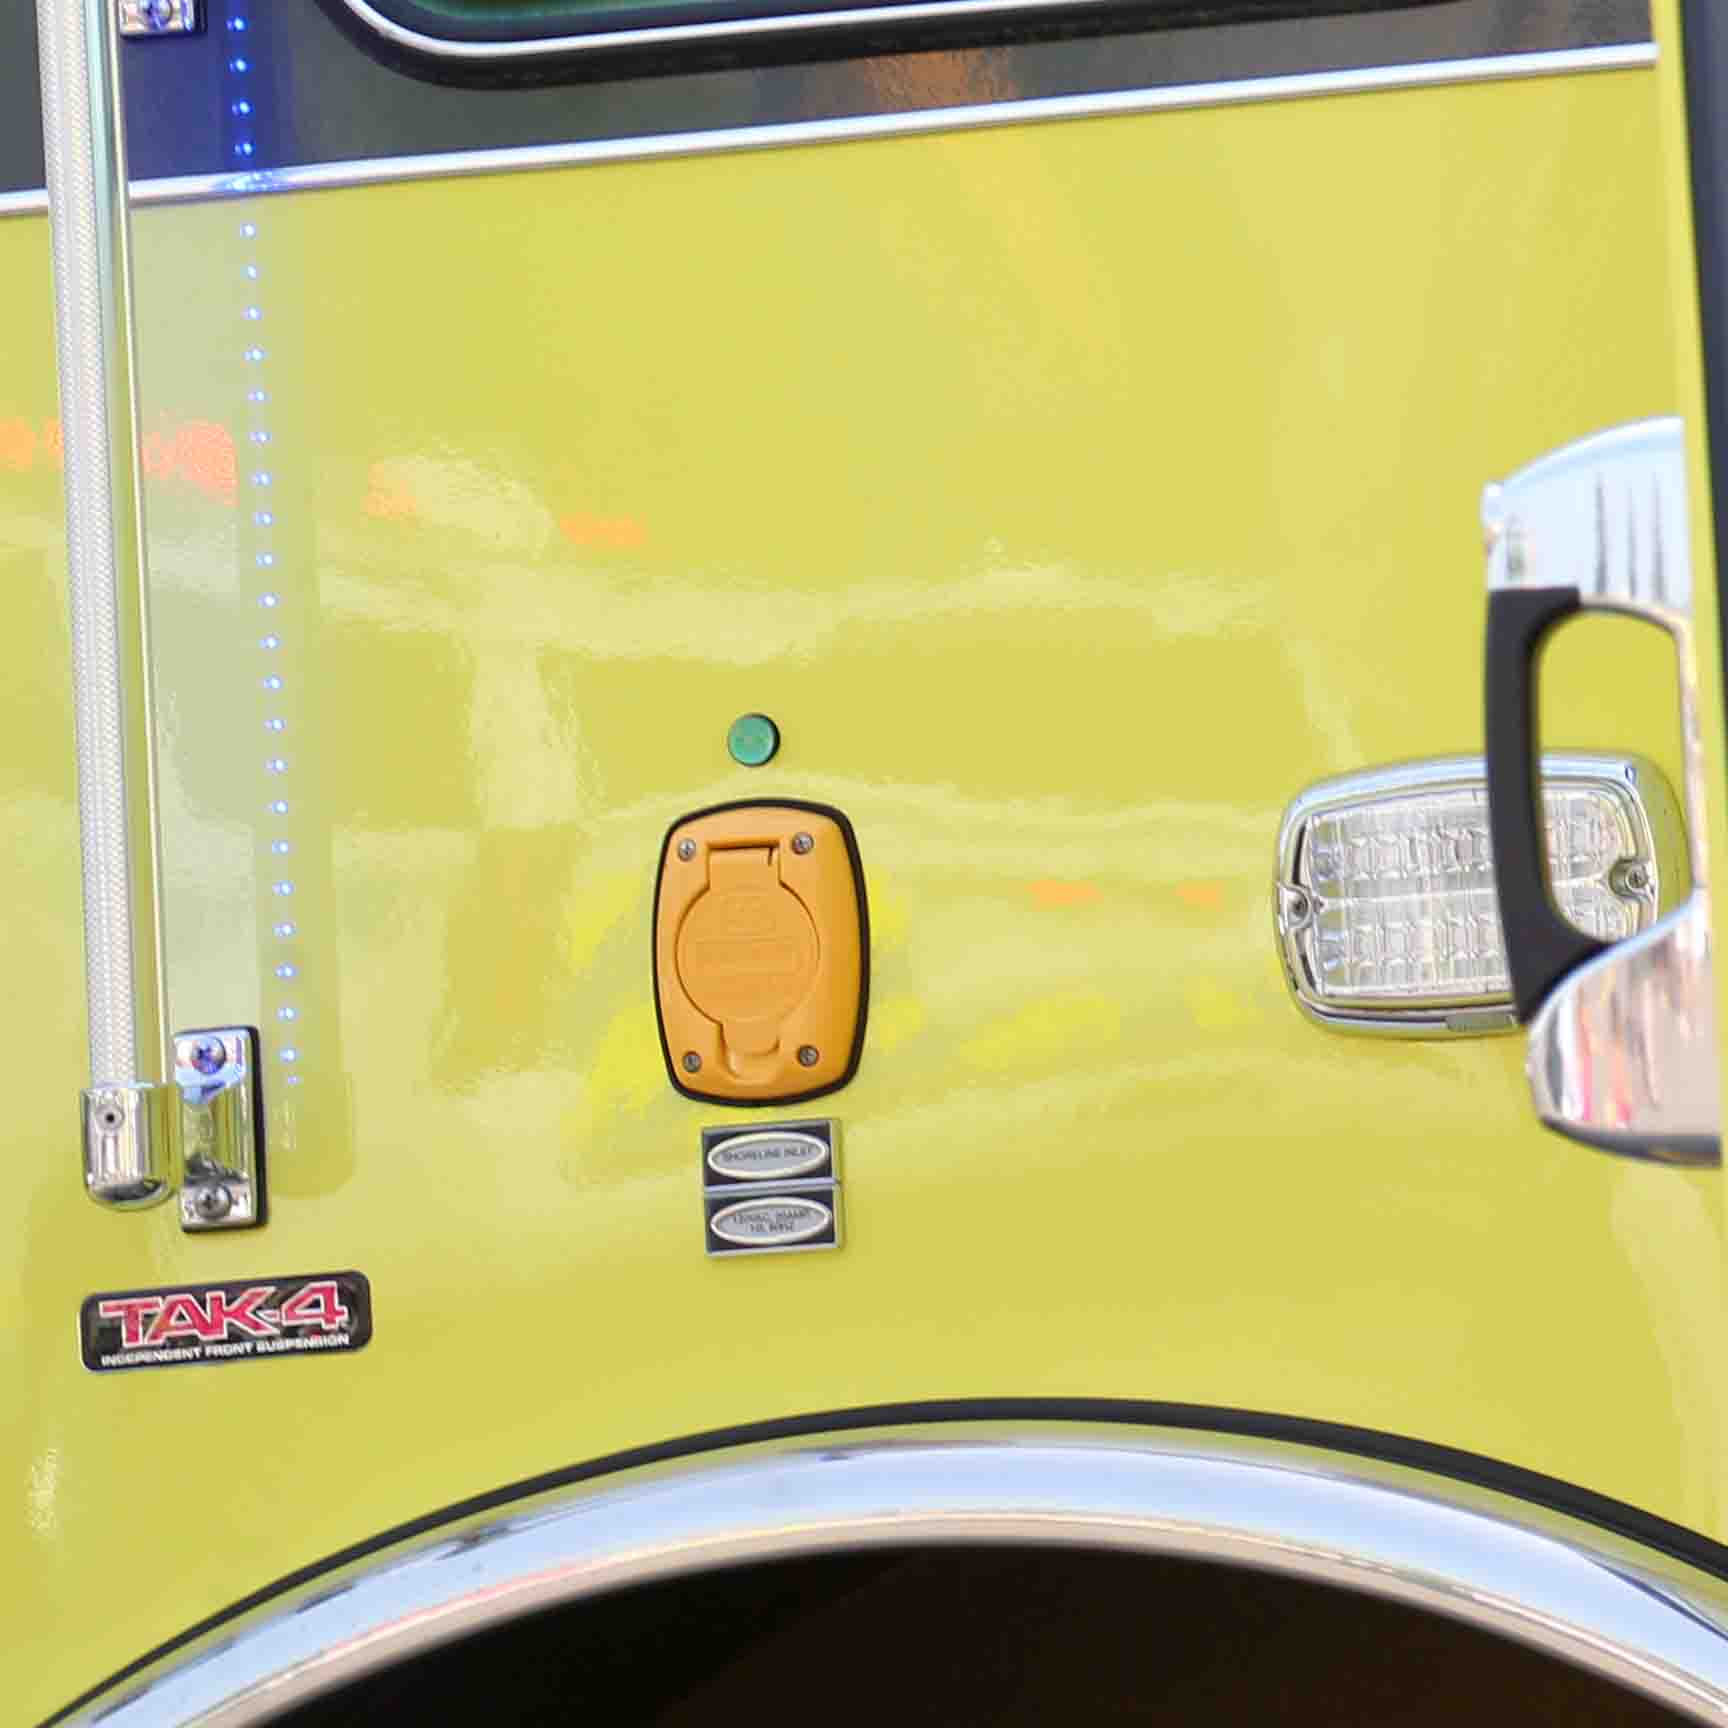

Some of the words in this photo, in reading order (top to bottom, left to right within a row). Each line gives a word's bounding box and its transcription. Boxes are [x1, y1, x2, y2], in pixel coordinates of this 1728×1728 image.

[98, 1279, 349, 1349] TAK-4
[101, 1346, 201, 1367] INDEPENDENT
[204, 1341, 253, 1357] FRONT
[256, 1332, 350, 1353] SUSPENSION
